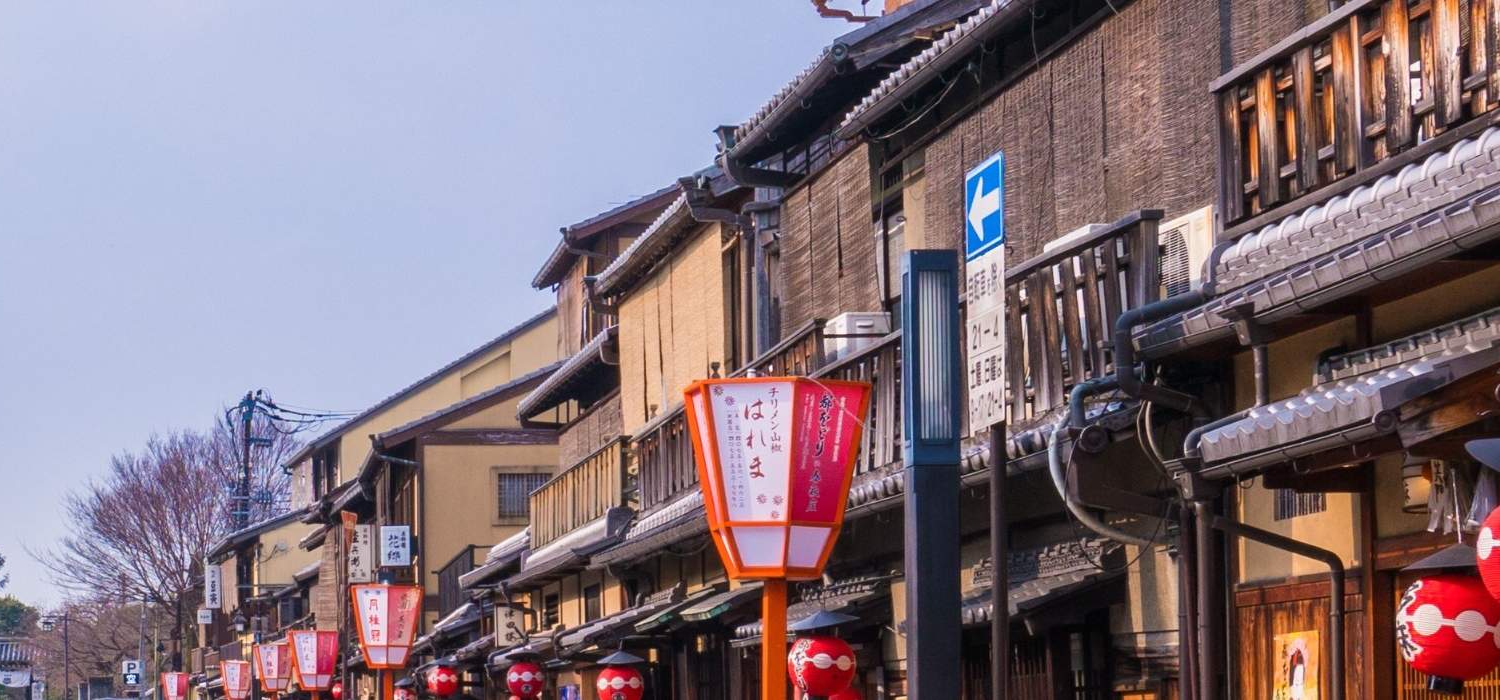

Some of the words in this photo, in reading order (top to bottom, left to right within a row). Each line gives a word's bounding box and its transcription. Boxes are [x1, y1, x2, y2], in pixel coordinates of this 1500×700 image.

[744, 399, 766, 478] はれま
[769, 388, 781, 453] チリメン山椒
[128, 663, 136, 673] P
